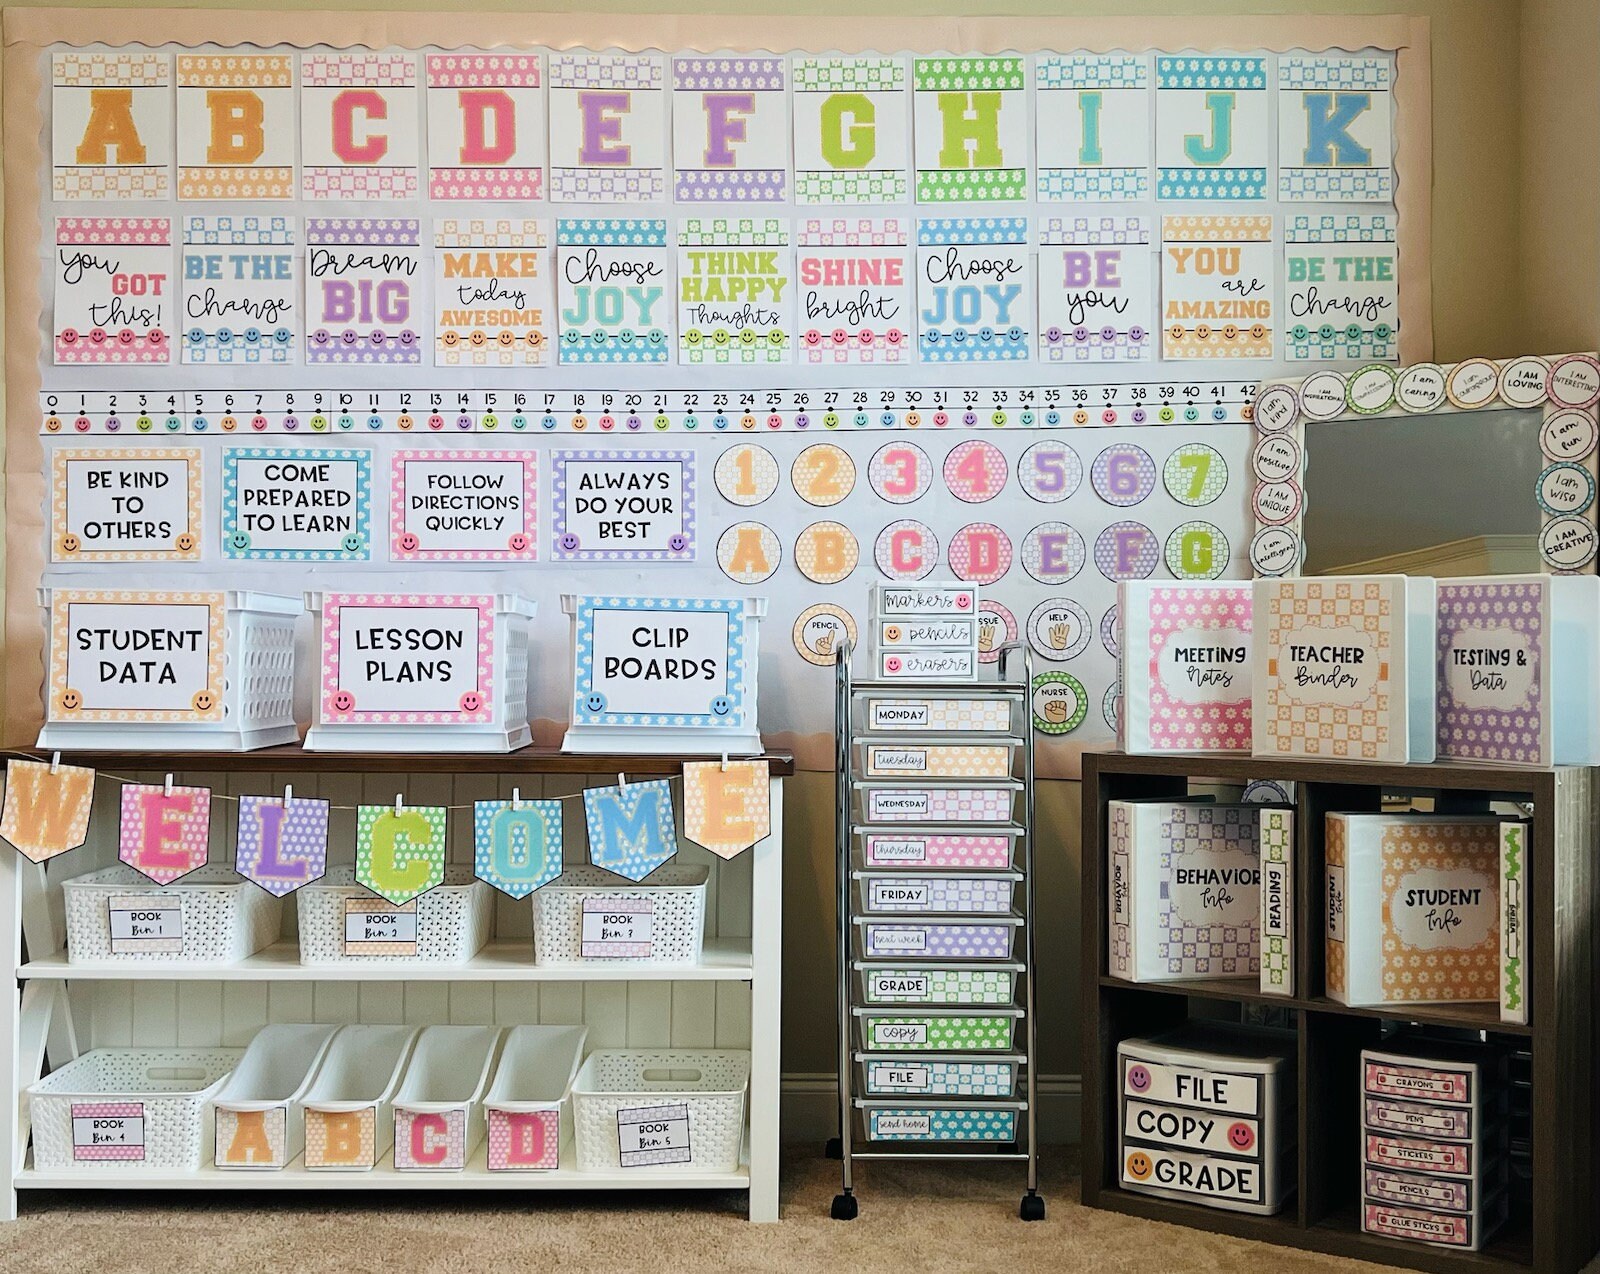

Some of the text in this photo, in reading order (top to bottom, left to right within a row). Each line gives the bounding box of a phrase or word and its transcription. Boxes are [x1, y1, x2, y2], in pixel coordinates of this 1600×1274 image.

[76, 89, 146, 164] A
[206, 90, 264, 164] B
[332, 89, 387, 164] C
[458, 90, 516, 164] D
[578, 91, 631, 166] E
[703, 92, 755, 167] F
[820, 93, 876, 169] G
[938, 92, 1003, 168] H
[1078, 91, 1102, 165] I
[1184, 91, 1236, 166] J
[1303, 91, 1371, 166] K
[184, 254, 292, 280] BE THE
[443, 252, 537, 279] MAKE
[688, 251, 779, 274] THINK
[801, 257, 904, 287] SHINE
[1063, 250, 1121, 288] BE
[1168, 247, 1241, 275] YOU
[1288, 256, 1394, 282] BE THE
[112, 273, 166, 296] GOT
[681, 276, 787, 302] HAPPY
[1222, 278, 1265, 296] are
[321, 279, 410, 324] BIG
[562, 285, 663, 327] JOY
[807, 290, 900, 325] bright
[921, 284, 1022, 326] JOY
[1067, 290, 1129, 325] you
[1166, 299, 1271, 320] AMAZING
[439, 310, 542, 327] AWESOME
[1508, 380, 1543, 390] LOVING
[46, 392, 412, 407] 0 1 2 3 4 5 6 7 8 9 10 11 12
[87, 470, 169, 489] BE KIND
[264, 464, 330, 482] COME
[427, 473, 504, 490] FOLLOW
[578, 472, 670, 491] ALWAYS
[734, 448, 757, 496] 1
[808, 450, 841, 497] 2
[883, 450, 919, 496] 3
[956, 448, 990, 496] 4
[1035, 450, 1066, 494] 5
[1108, 453, 1140, 496] 6
[1180, 454, 1212, 499] 7
[111, 496, 144, 514] TO
[243, 488, 351, 508] PREPARED
[412, 494, 519, 511] DIRECTIONS
[575, 496, 673, 515] DO YOUR
[1259, 498, 1290, 514] UNIQUE
[83, 521, 171, 539] OTHERS
[243, 513, 351, 533] TO LEARN
[425, 515, 504, 532] QUICKLY
[598, 521, 651, 539] BEST
[727, 528, 769, 574] A
[812, 529, 846, 574] B
[891, 529, 922, 574] C
[966, 531, 1000, 576] D
[1039, 534, 1069, 575] E
[1114, 531, 1145, 574] F
[1181, 530, 1212, 574] G
[1546, 533, 1593, 555] CREATIVE
[886, 591, 953, 609] markers
[811, 620, 839, 631] PENCIL
[1048, 613, 1069, 623] HELP
[76, 628, 203, 652] STUDENT
[355, 627, 463, 652] LESSON
[632, 626, 689, 650] CLIP
[909, 624, 969, 642] pencils
[907, 658, 968, 672] erasers
[1290, 644, 1364, 665] TEACHER
[1515, 648, 1527, 666] &
[99, 660, 177, 685] DATA
[366, 659, 453, 683] PLANS
[605, 656, 717, 681] BOARDS
[1294, 670, 1359, 689] Binder
[1041, 687, 1068, 697] NURSE
[879, 709, 925, 720] MONDAY
[877, 753, 924, 769] tuesday
[877, 799, 927, 809] WEDNESDAY
[1176, 868, 1260, 886] BEHAVIOR
[880, 889, 923, 900] FRIDAY
[1328, 874, 1336, 932] STUDENT
[1405, 888, 1481, 907] STUDENT
[131, 911, 162, 922] BOOK
[366, 915, 397, 925] BOOK
[603, 915, 632, 924] BOOK
[131, 924, 155, 936] Bin
[365, 927, 388, 940] Bin
[602, 927, 623, 940] Bin
[879, 979, 923, 991] GRADE
[883, 1026, 919, 1042] copy
[889, 1071, 914, 1083] FILE
[1396, 1078, 1434, 1090] CRAYONS
[1176, 1074, 1228, 1104] FILE
[93, 1119, 124, 1129] BOOK
[639, 1123, 669, 1134] BOOK
[1137, 1110, 1214, 1144] COPY
[1405, 1115, 1424, 1124] PENS
[92, 1132, 115, 1144] Bin
[226, 1112, 274, 1163] A
[322, 1111, 362, 1163] B
[411, 1112, 447, 1164] C
[506, 1112, 546, 1163] D
[639, 1137, 661, 1149] Bin
[1397, 1149, 1433, 1161] STICKERS
[1155, 1158, 1252, 1194] GRADE
[1400, 1185, 1430, 1196] PENCILS
[1391, 1217, 1440, 1232] GLUE STICKS
